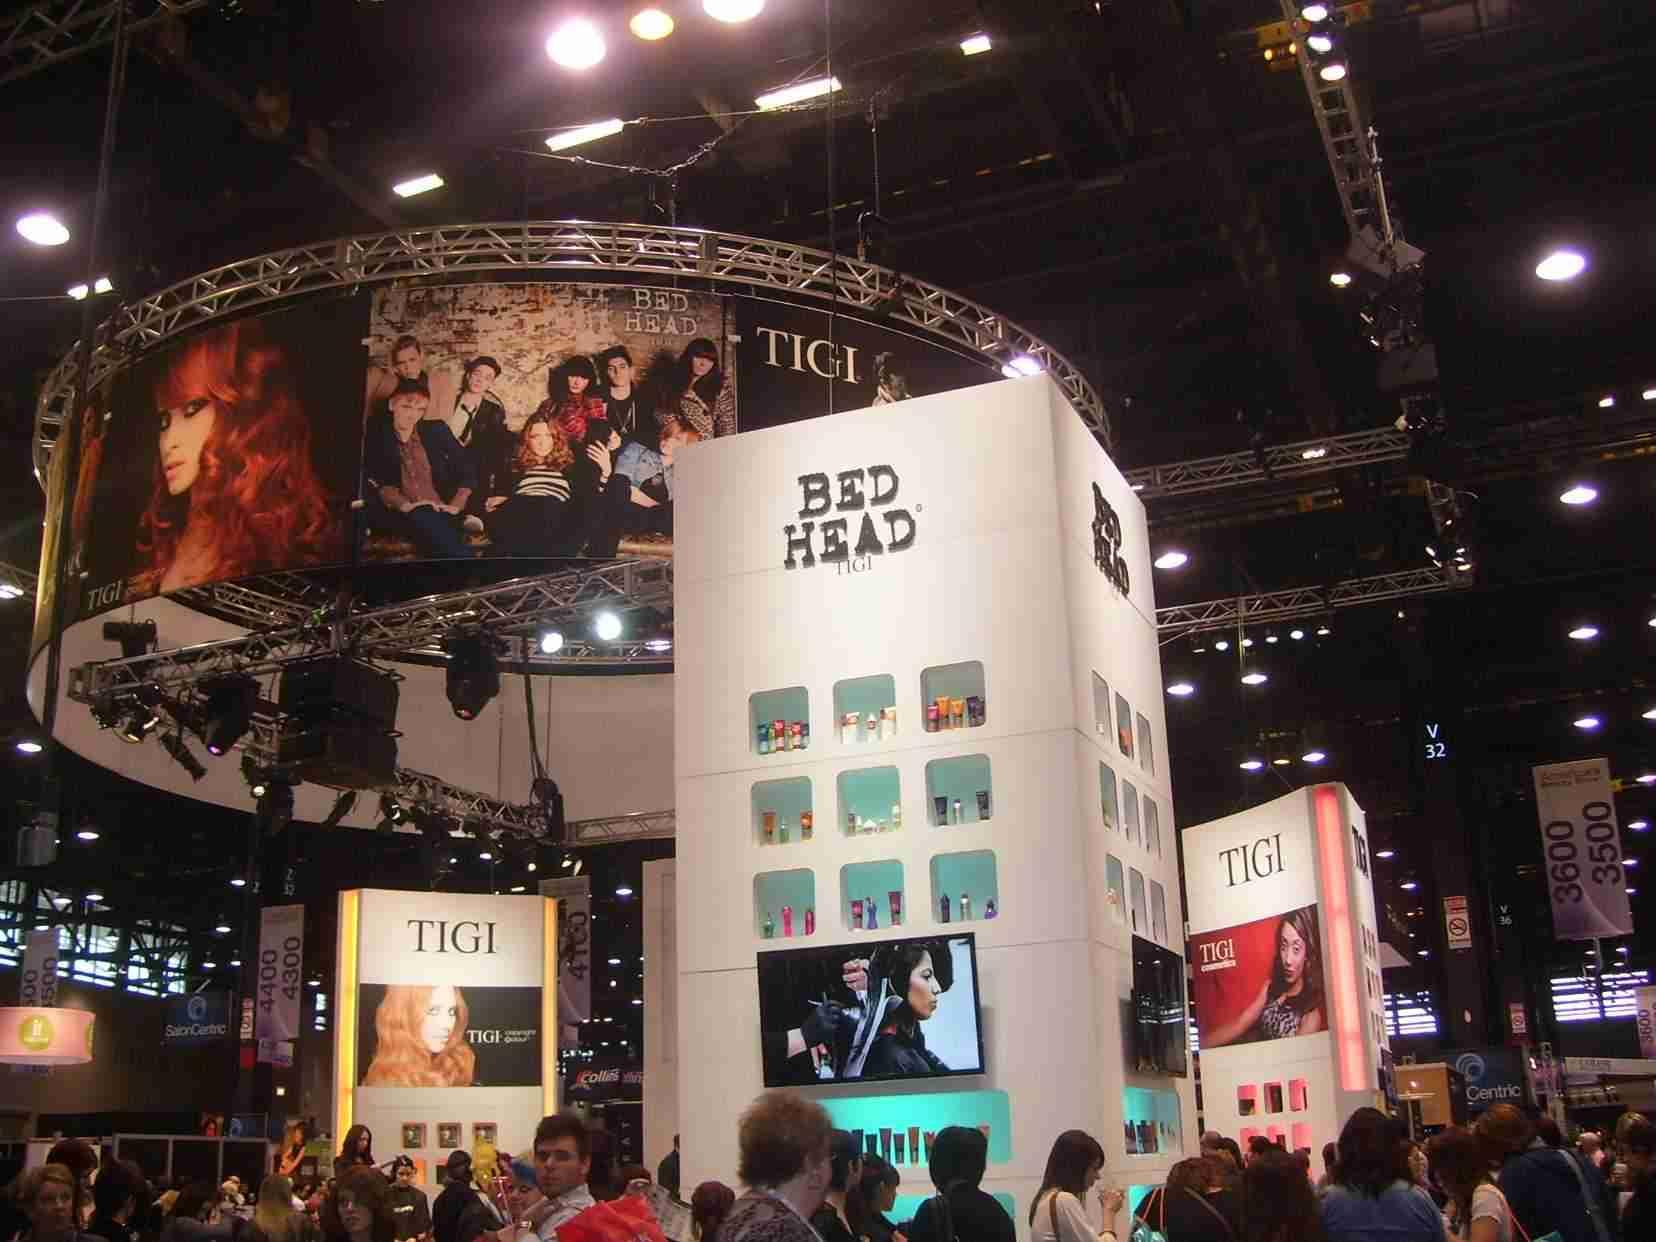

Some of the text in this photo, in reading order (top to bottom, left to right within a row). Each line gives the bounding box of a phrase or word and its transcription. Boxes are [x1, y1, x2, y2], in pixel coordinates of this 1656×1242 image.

[632, 288, 689, 312] BED
[624, 311, 697, 336] HEAD
[756, 326, 860, 385] TIGI
[797, 464, 899, 520] BED
[783, 509, 917, 570] HEAD
[87, 579, 123, 611] TIGI
[1426, 723, 1439, 738] V
[1425, 742, 1447, 759] 32
[1218, 832, 1285, 888] TIGI
[1583, 801, 1621, 886] 3500
[1546, 820, 1583, 904] 3600
[407, 919, 498, 955] TIGI
[1199, 938, 1234, 963] TIGI
[259, 950, 278, 1016] 4400
[281, 935, 301, 1001] 4300
[466, 1029, 500, 1044] TIGI
[1465, 1082, 1521, 1102] Centric
